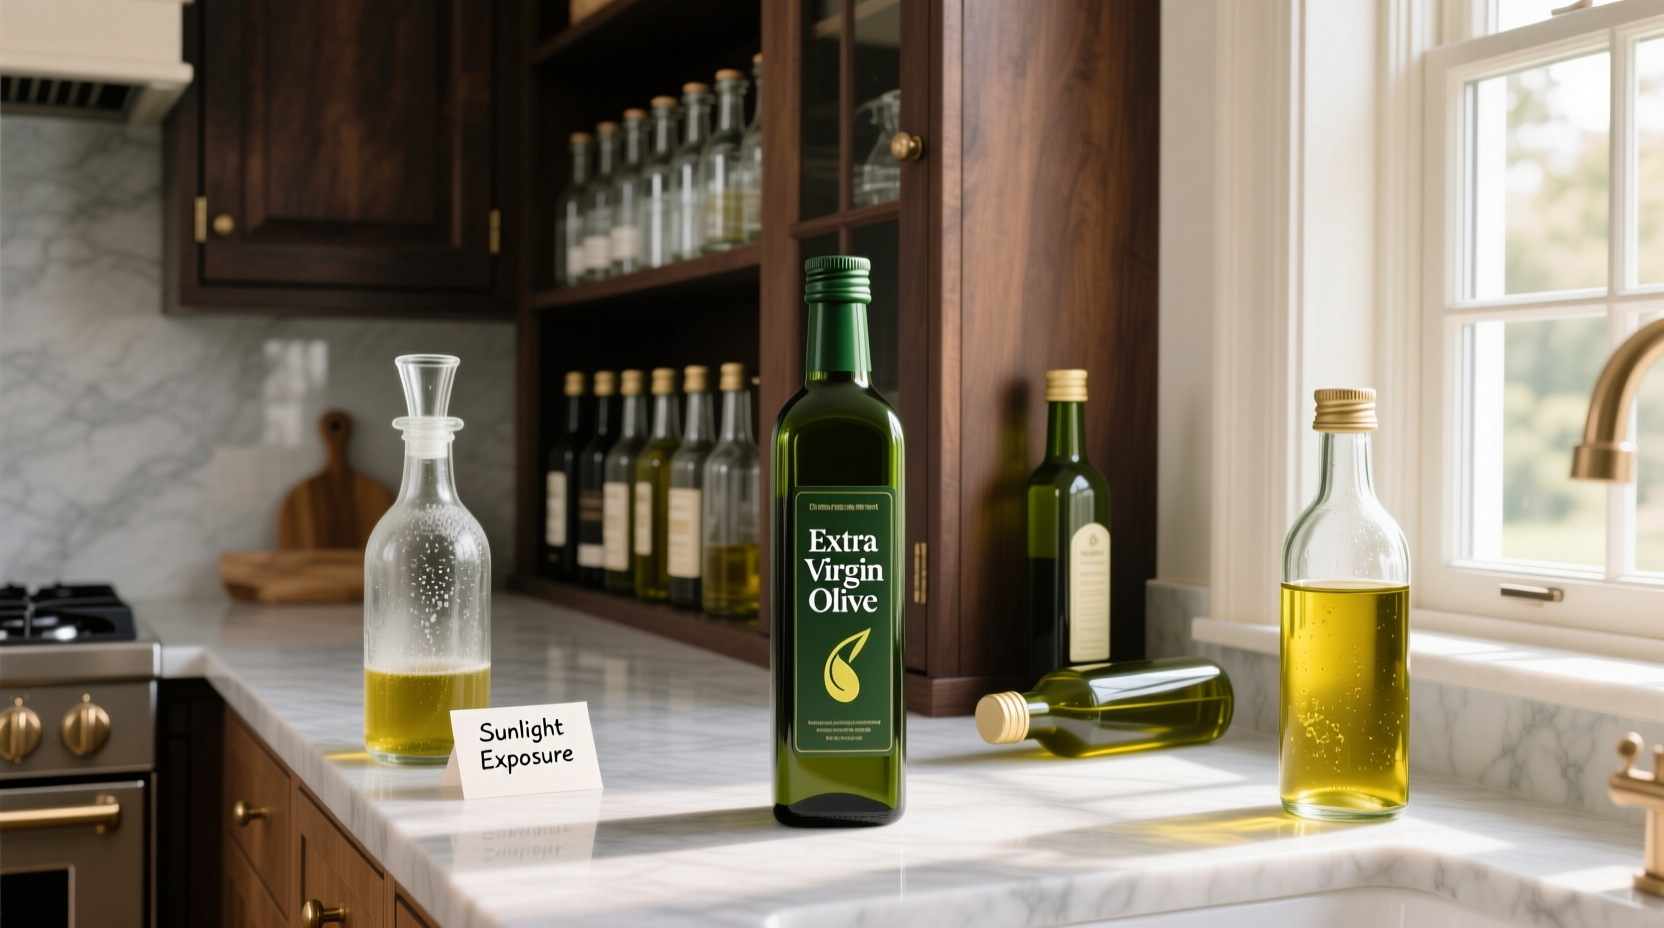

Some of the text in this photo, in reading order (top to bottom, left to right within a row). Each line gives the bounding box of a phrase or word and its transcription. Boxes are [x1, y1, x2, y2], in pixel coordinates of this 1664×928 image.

[808, 528, 878, 552] Extra
[804, 557, 884, 590] Virgin
[808, 586, 878, 613] Olive
[480, 717, 564, 743] Sunlight
[480, 748, 574, 775] Exposure
